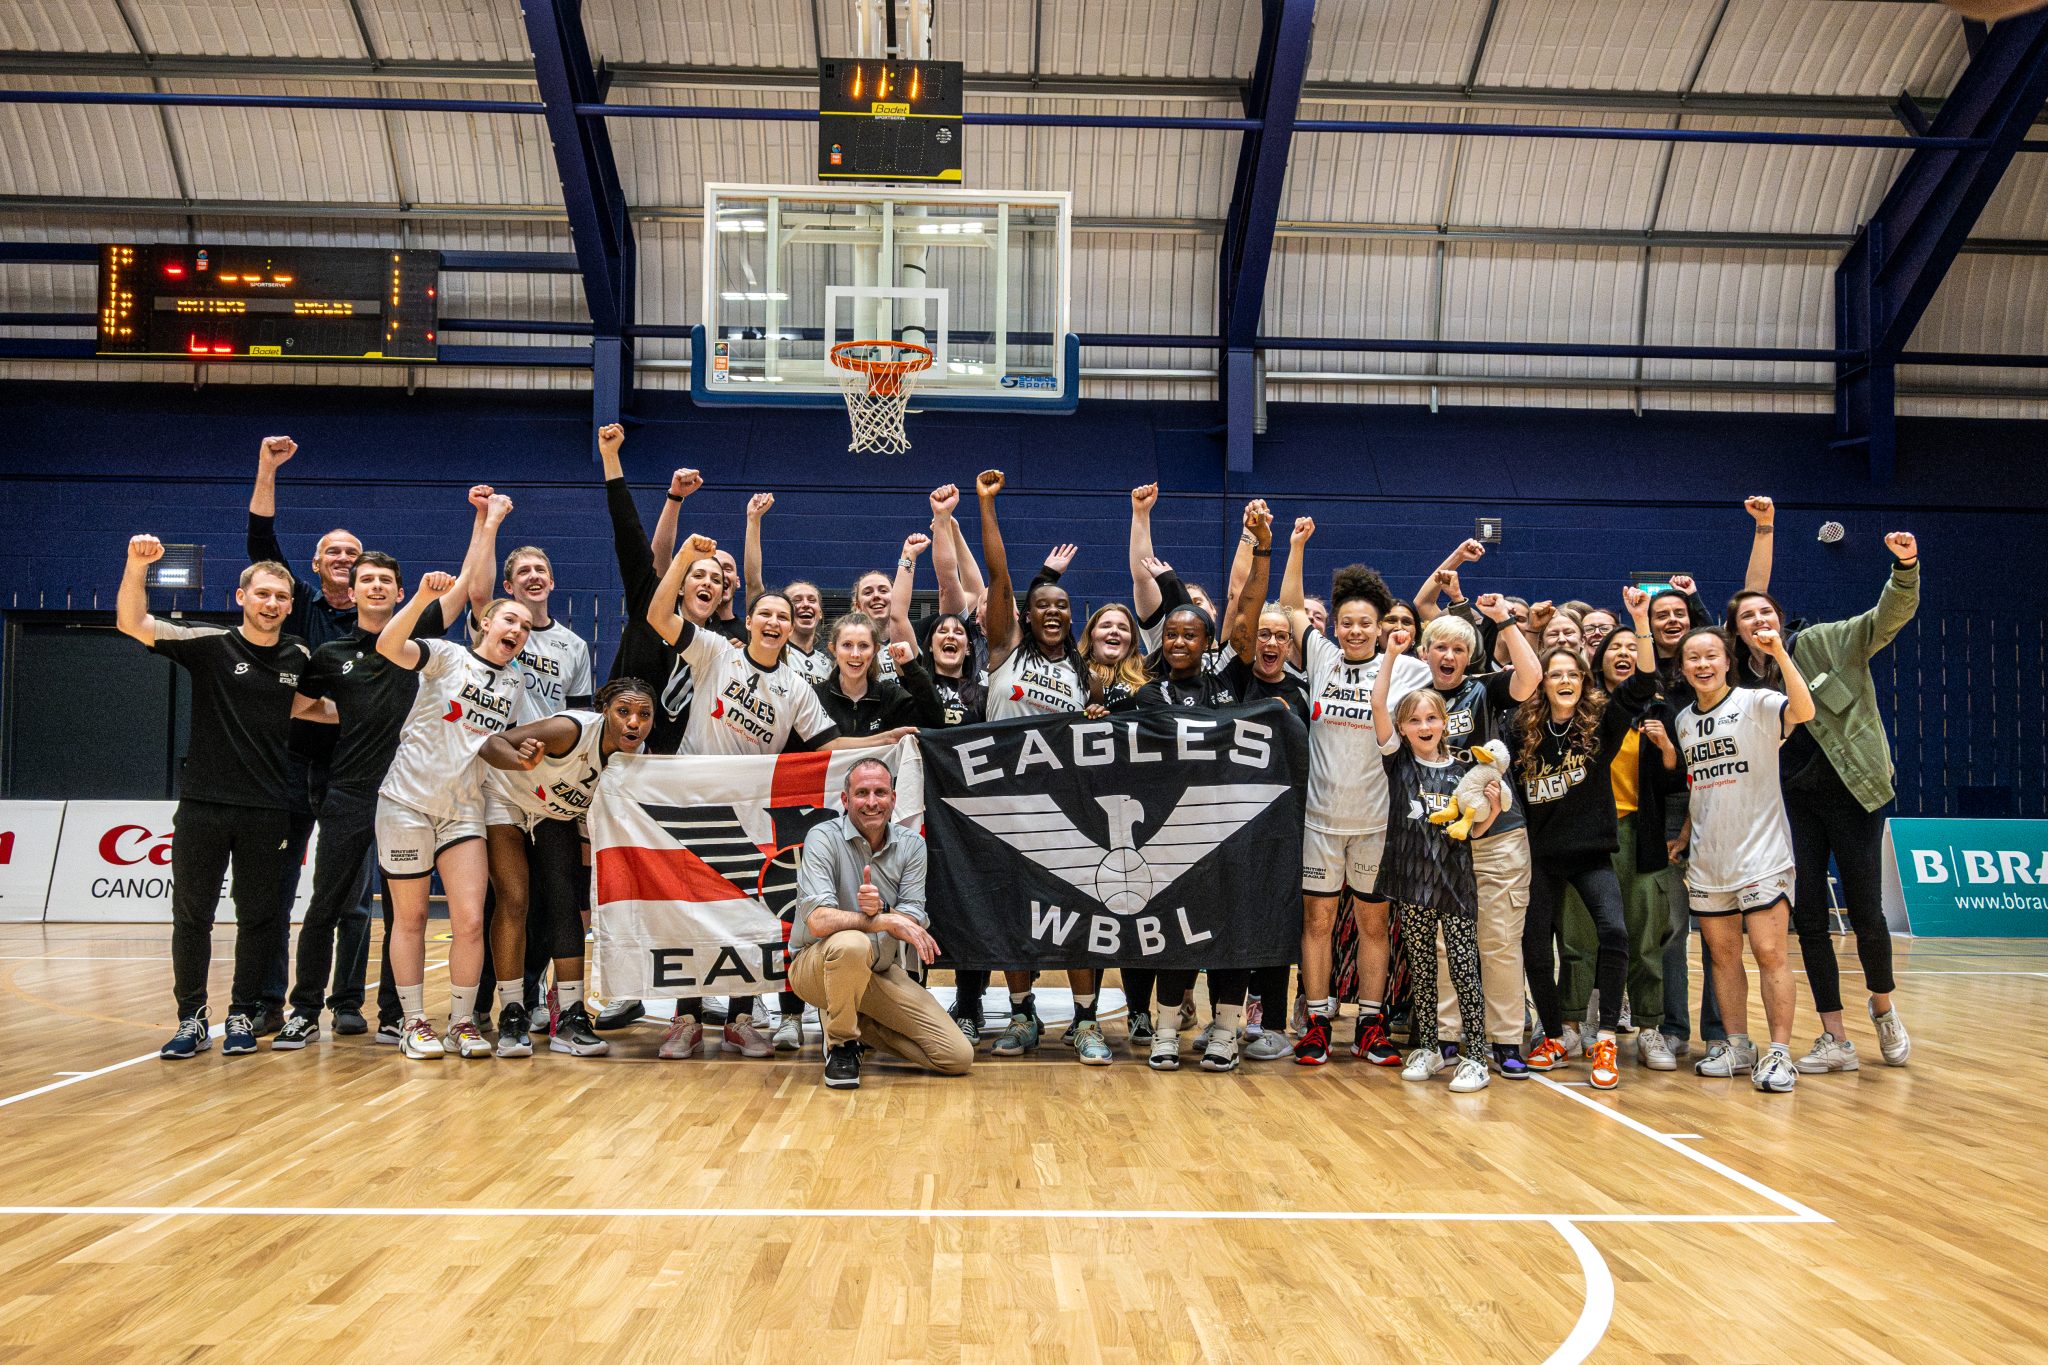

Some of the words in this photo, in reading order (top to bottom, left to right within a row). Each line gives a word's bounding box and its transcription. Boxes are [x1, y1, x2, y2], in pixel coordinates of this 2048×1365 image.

[875, 104, 908, 114] Bodet
[251, 346, 280, 355] Bodet
[518, 649, 560, 676] AGLES
[804, 659, 814, 671] 9
[1042, 664, 1061, 680] 15
[483, 670, 496, 693] 2
[747, 672, 761, 694] 4
[1020, 669, 1073, 698] EAGLES
[1345, 668, 1360, 685] 11
[458, 681, 514, 719] EAGLES
[722, 678, 776, 726] EAGLES
[1027, 688, 1076, 712] marra
[1321, 682, 1372, 704] EAGLE
[1324, 718, 1347, 727] Forward
[1325, 704, 1373, 721] marr
[727, 706, 775, 744] marra
[1695, 717, 1715, 737] 10
[952, 717, 1273, 786] EAGLES
[1684, 737, 1738, 767] EAGLES
[1693, 761, 1749, 782] marra
[550, 779, 593, 809] EAGL
[1354, 862, 1378, 873] muc
[1030, 899, 1212, 956] WBBL
[649, 941, 791, 988] EAG
